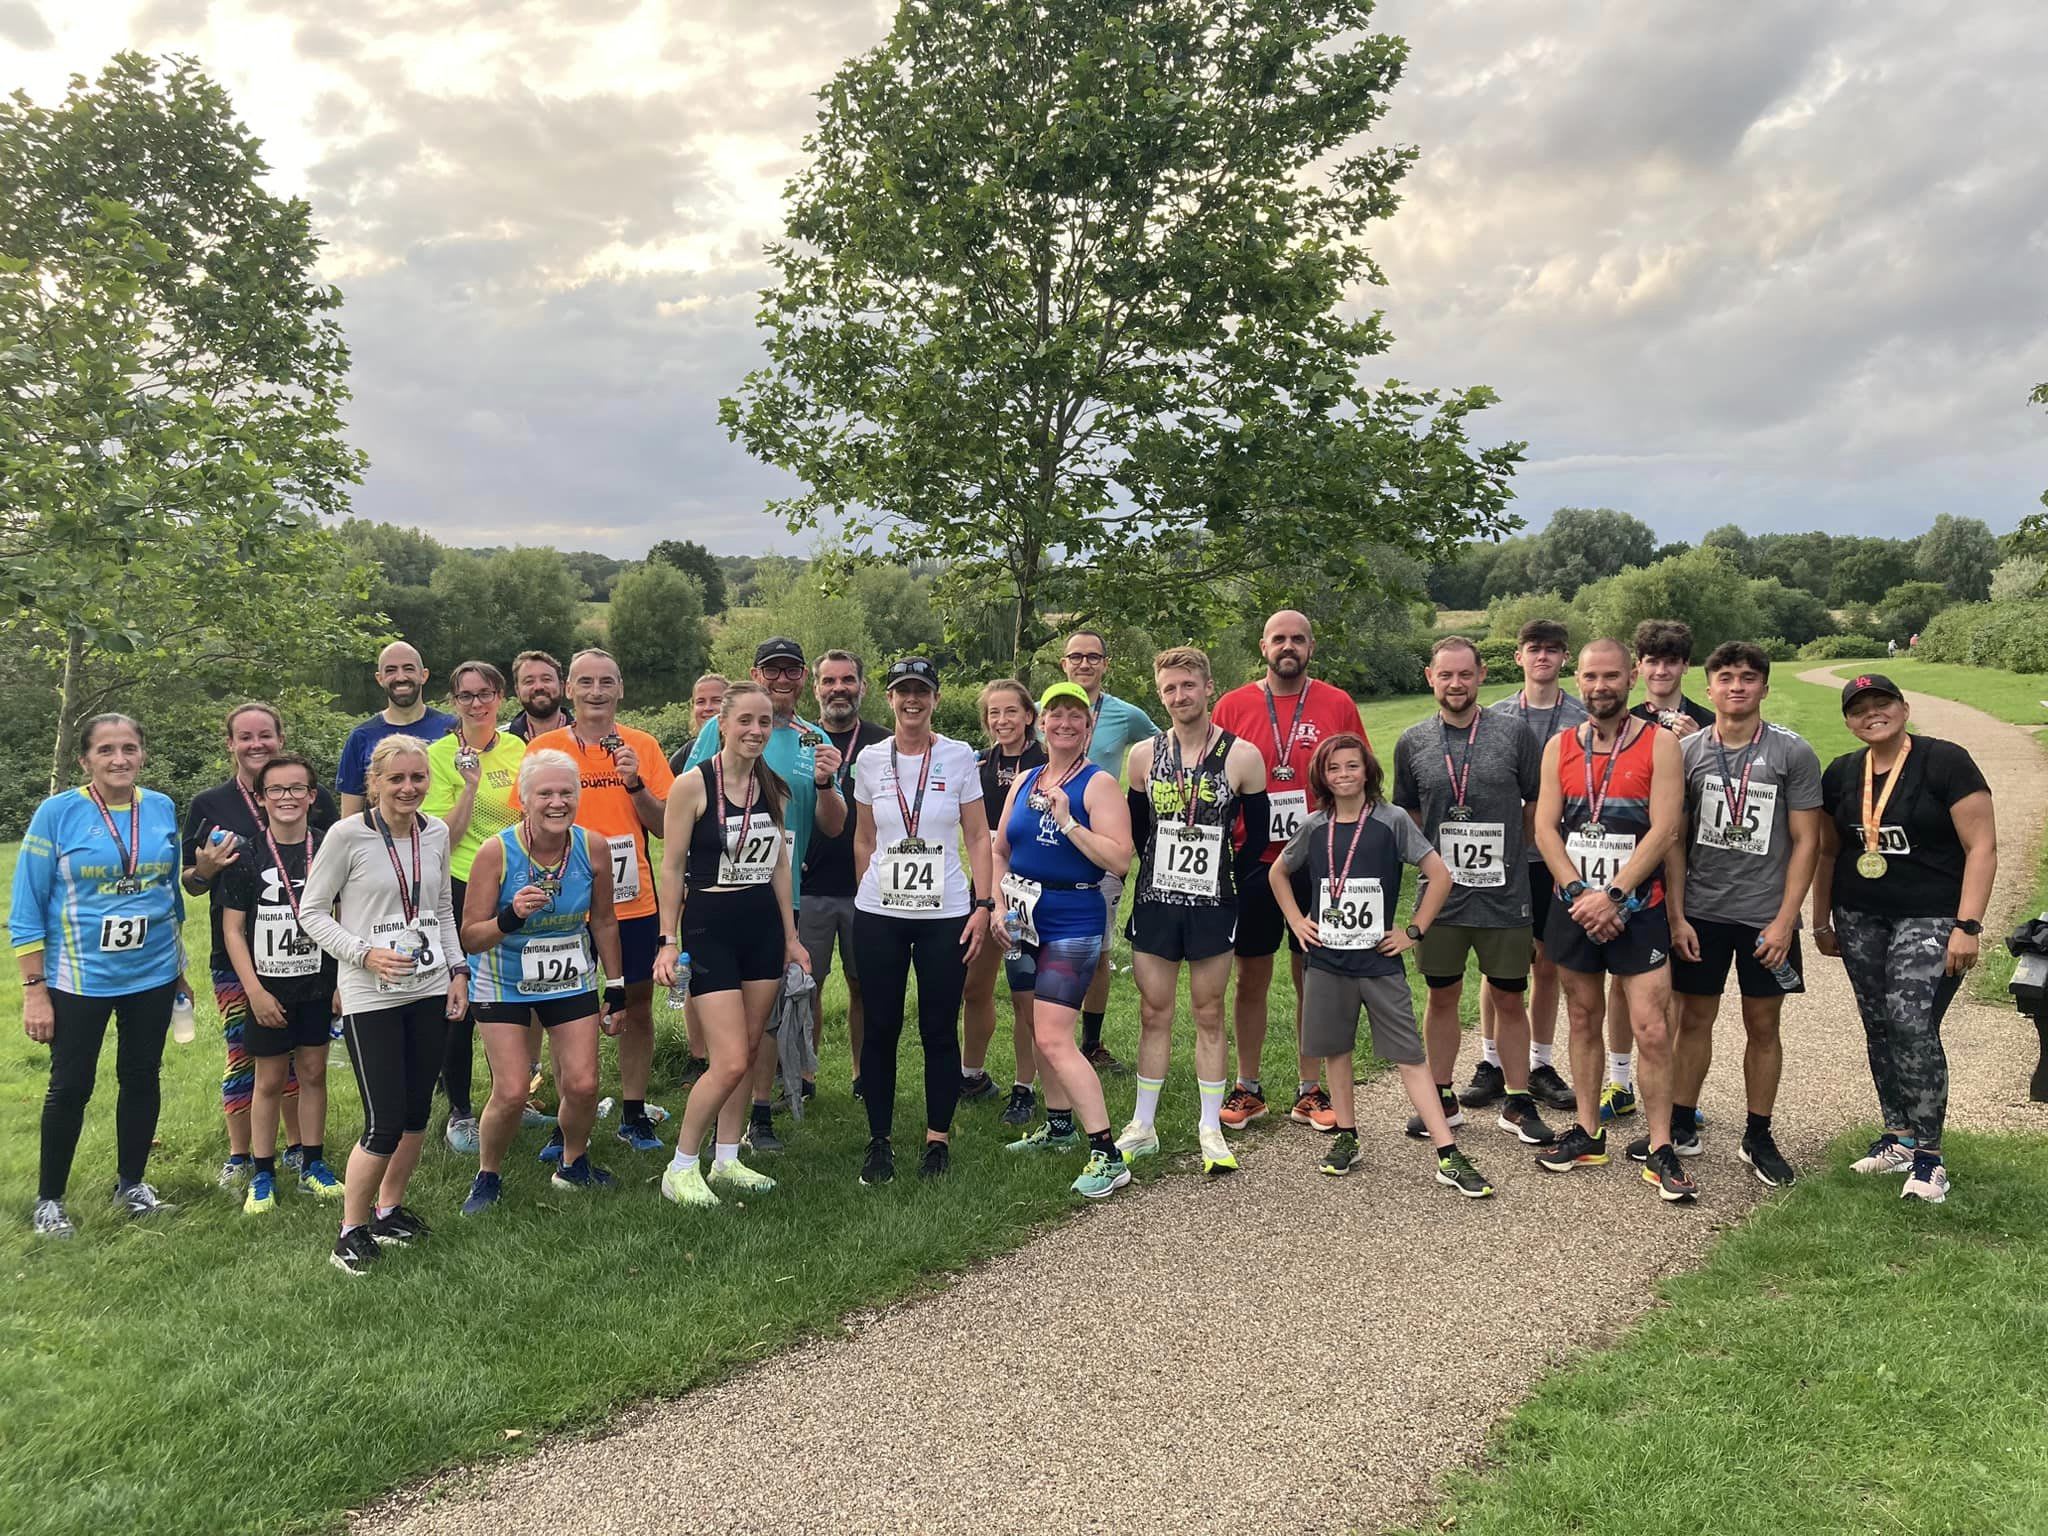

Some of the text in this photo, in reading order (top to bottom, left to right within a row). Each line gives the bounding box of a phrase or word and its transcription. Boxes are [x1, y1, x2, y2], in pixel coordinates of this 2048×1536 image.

[487, 769, 509, 780] RUN
[1273, 797, 1305, 807] RUNNING
[1441, 828, 1503, 837] ENIGMA RUNNING
[1569, 838, 1634, 851] ENIGMA RUNNING
[1168, 844, 1209, 875] 128
[1453, 843, 1492, 869] 125
[81, 865, 106, 879] MK
[893, 862, 934, 891] 124
[1580, 856, 1620, 886] 141
[1348, 885, 1381, 894] RUNNING
[102, 918, 147, 948] 131
[373, 921, 406, 935] ENIGMA
[267, 928, 308, 957] 14
[537, 957, 579, 983] 126
